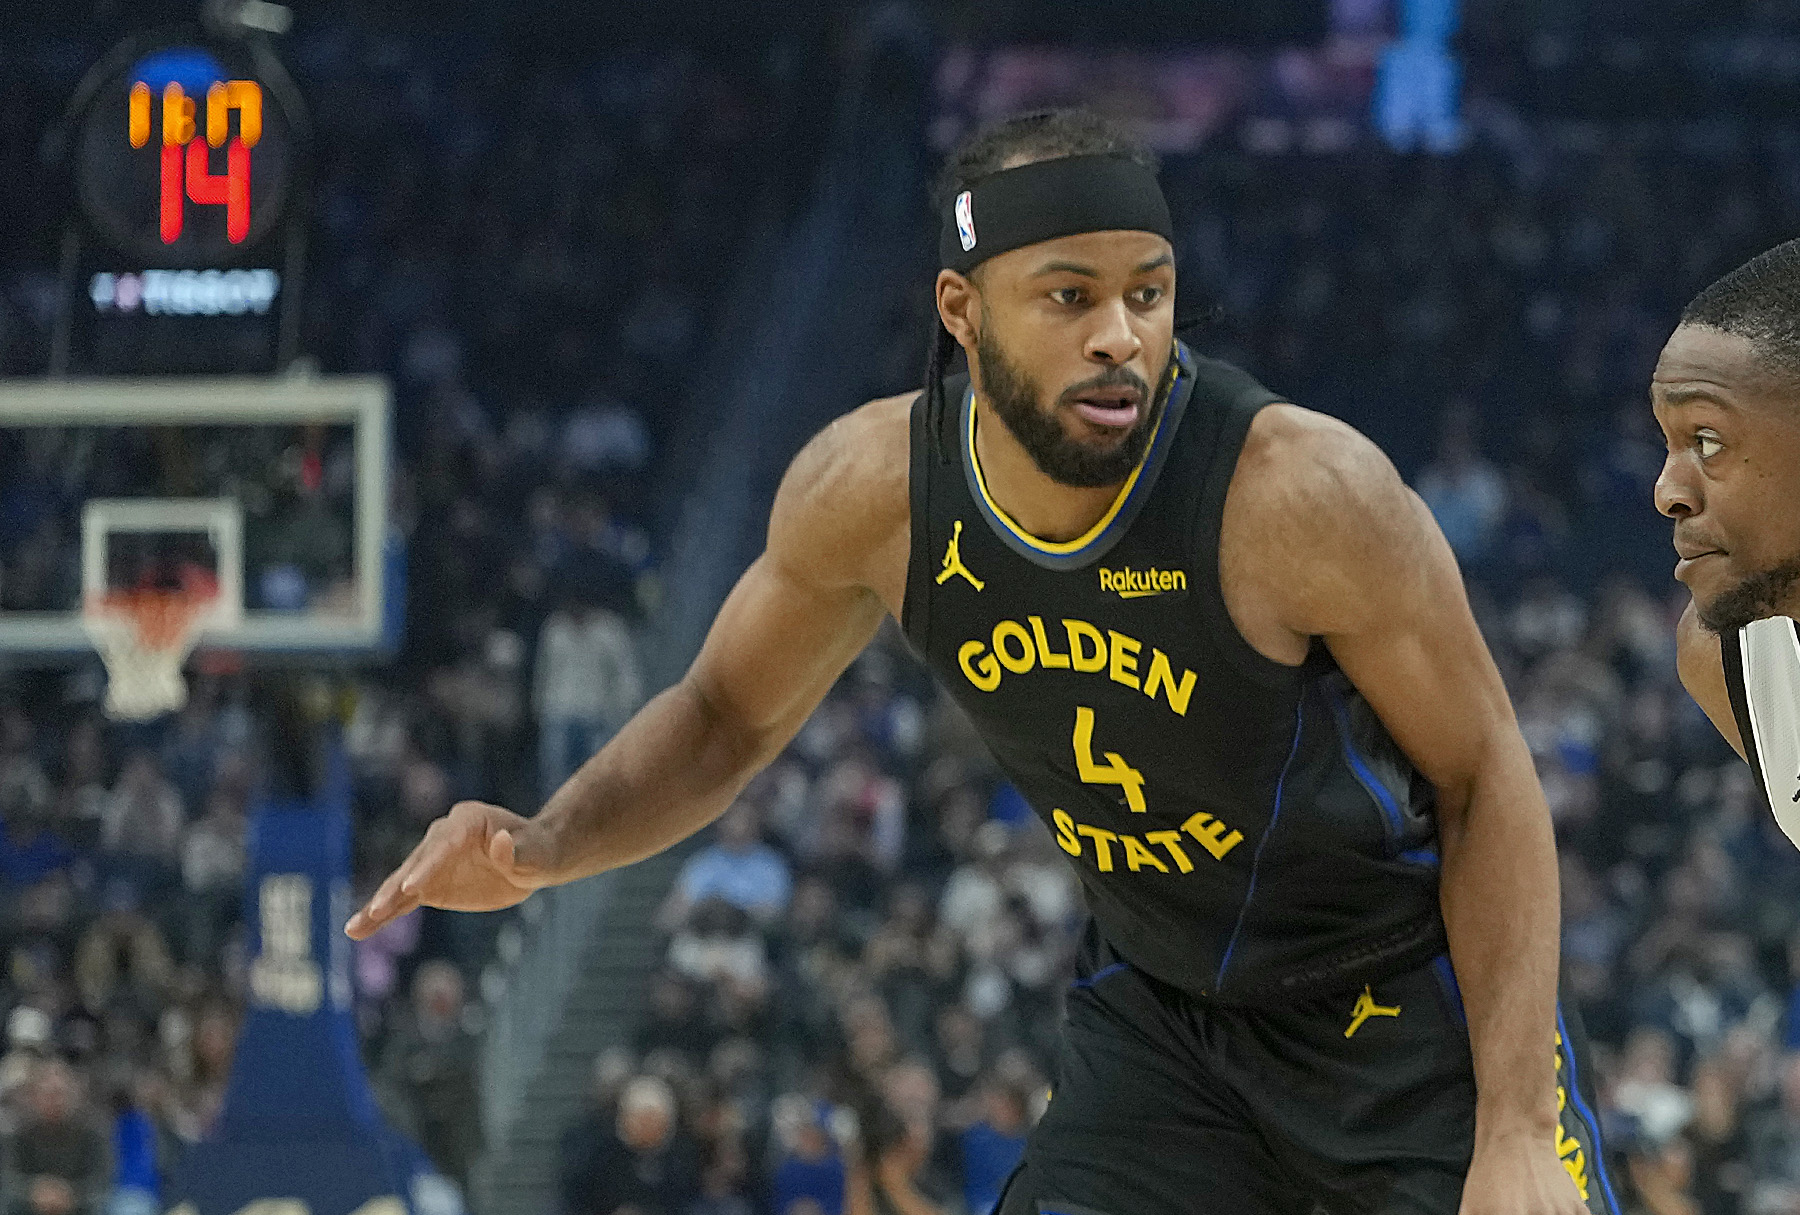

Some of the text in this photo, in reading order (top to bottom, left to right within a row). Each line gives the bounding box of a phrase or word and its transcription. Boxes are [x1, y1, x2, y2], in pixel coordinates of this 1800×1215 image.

[160, 135, 250, 245] 14
[1098, 566, 1187, 593] Rakuten
[957, 615, 1198, 718] GOLDEN
[1072, 706, 1147, 813] 4
[1052, 808, 1245, 874] STATE
